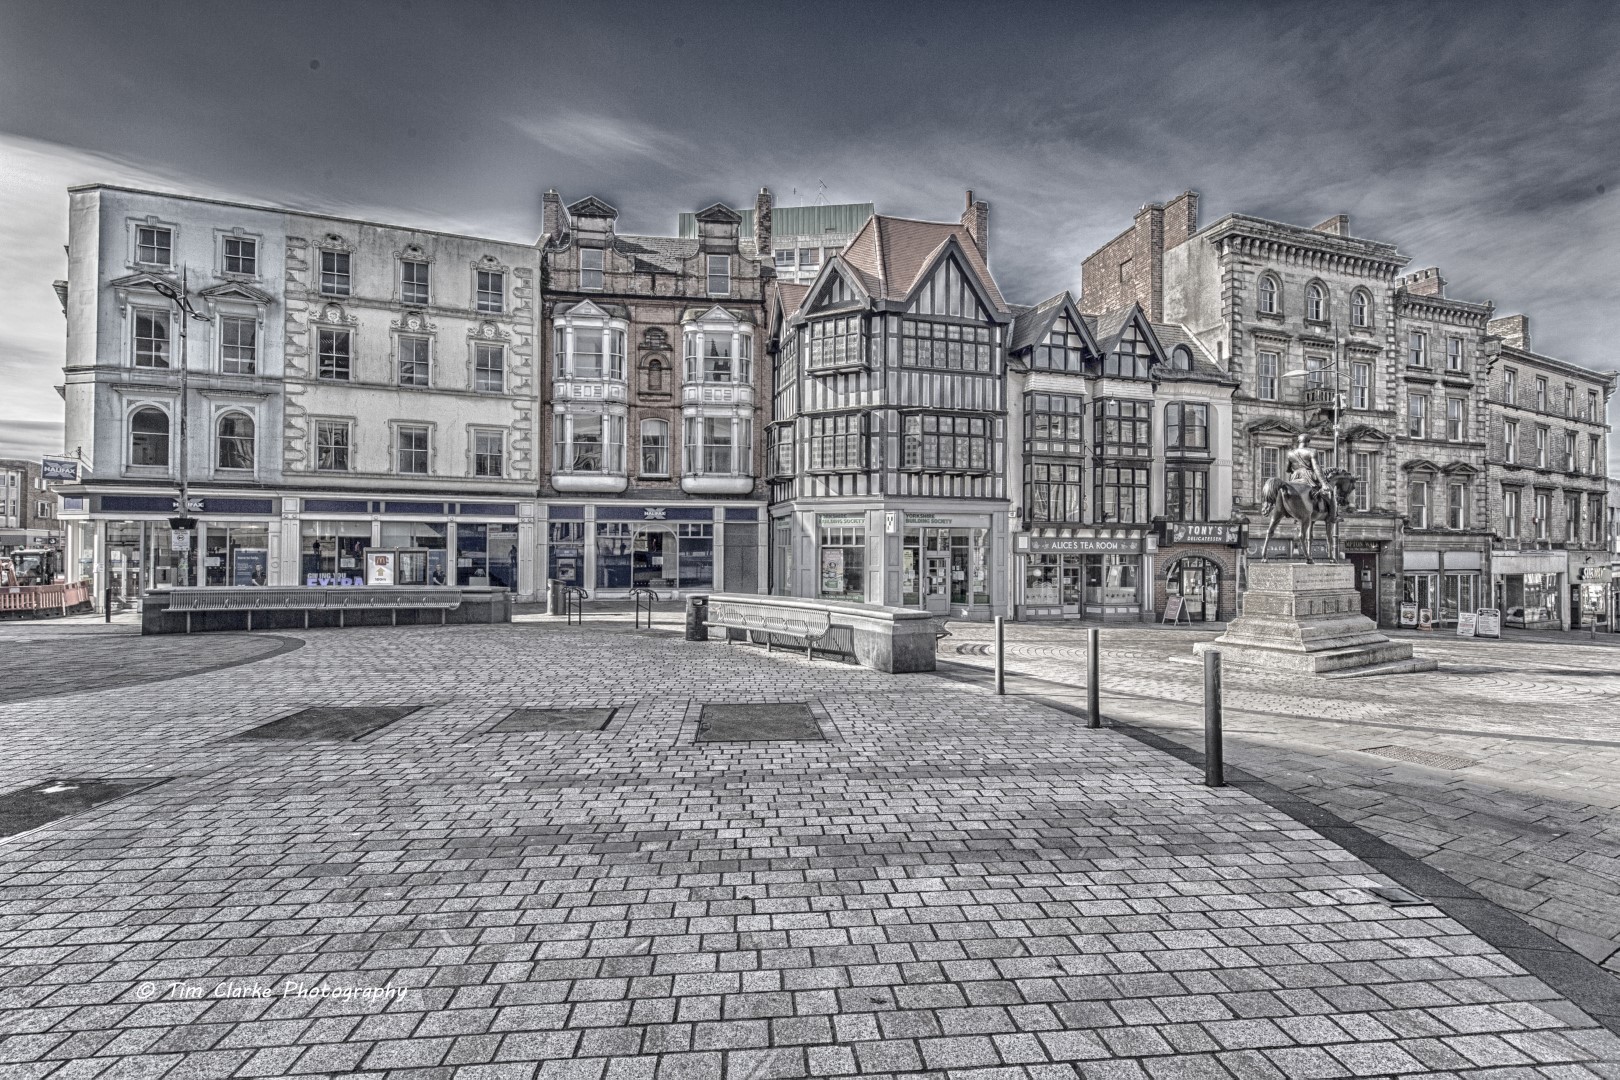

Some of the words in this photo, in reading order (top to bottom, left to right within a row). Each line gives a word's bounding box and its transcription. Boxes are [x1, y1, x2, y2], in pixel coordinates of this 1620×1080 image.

[43, 466, 76, 474] HALIFAX
[1188, 525, 1223, 535] TONY'S
[1051, 541, 1078, 549] ALICE'S
[1080, 541, 1094, 549] TEA
[1096, 541, 1118, 549] ROOM
